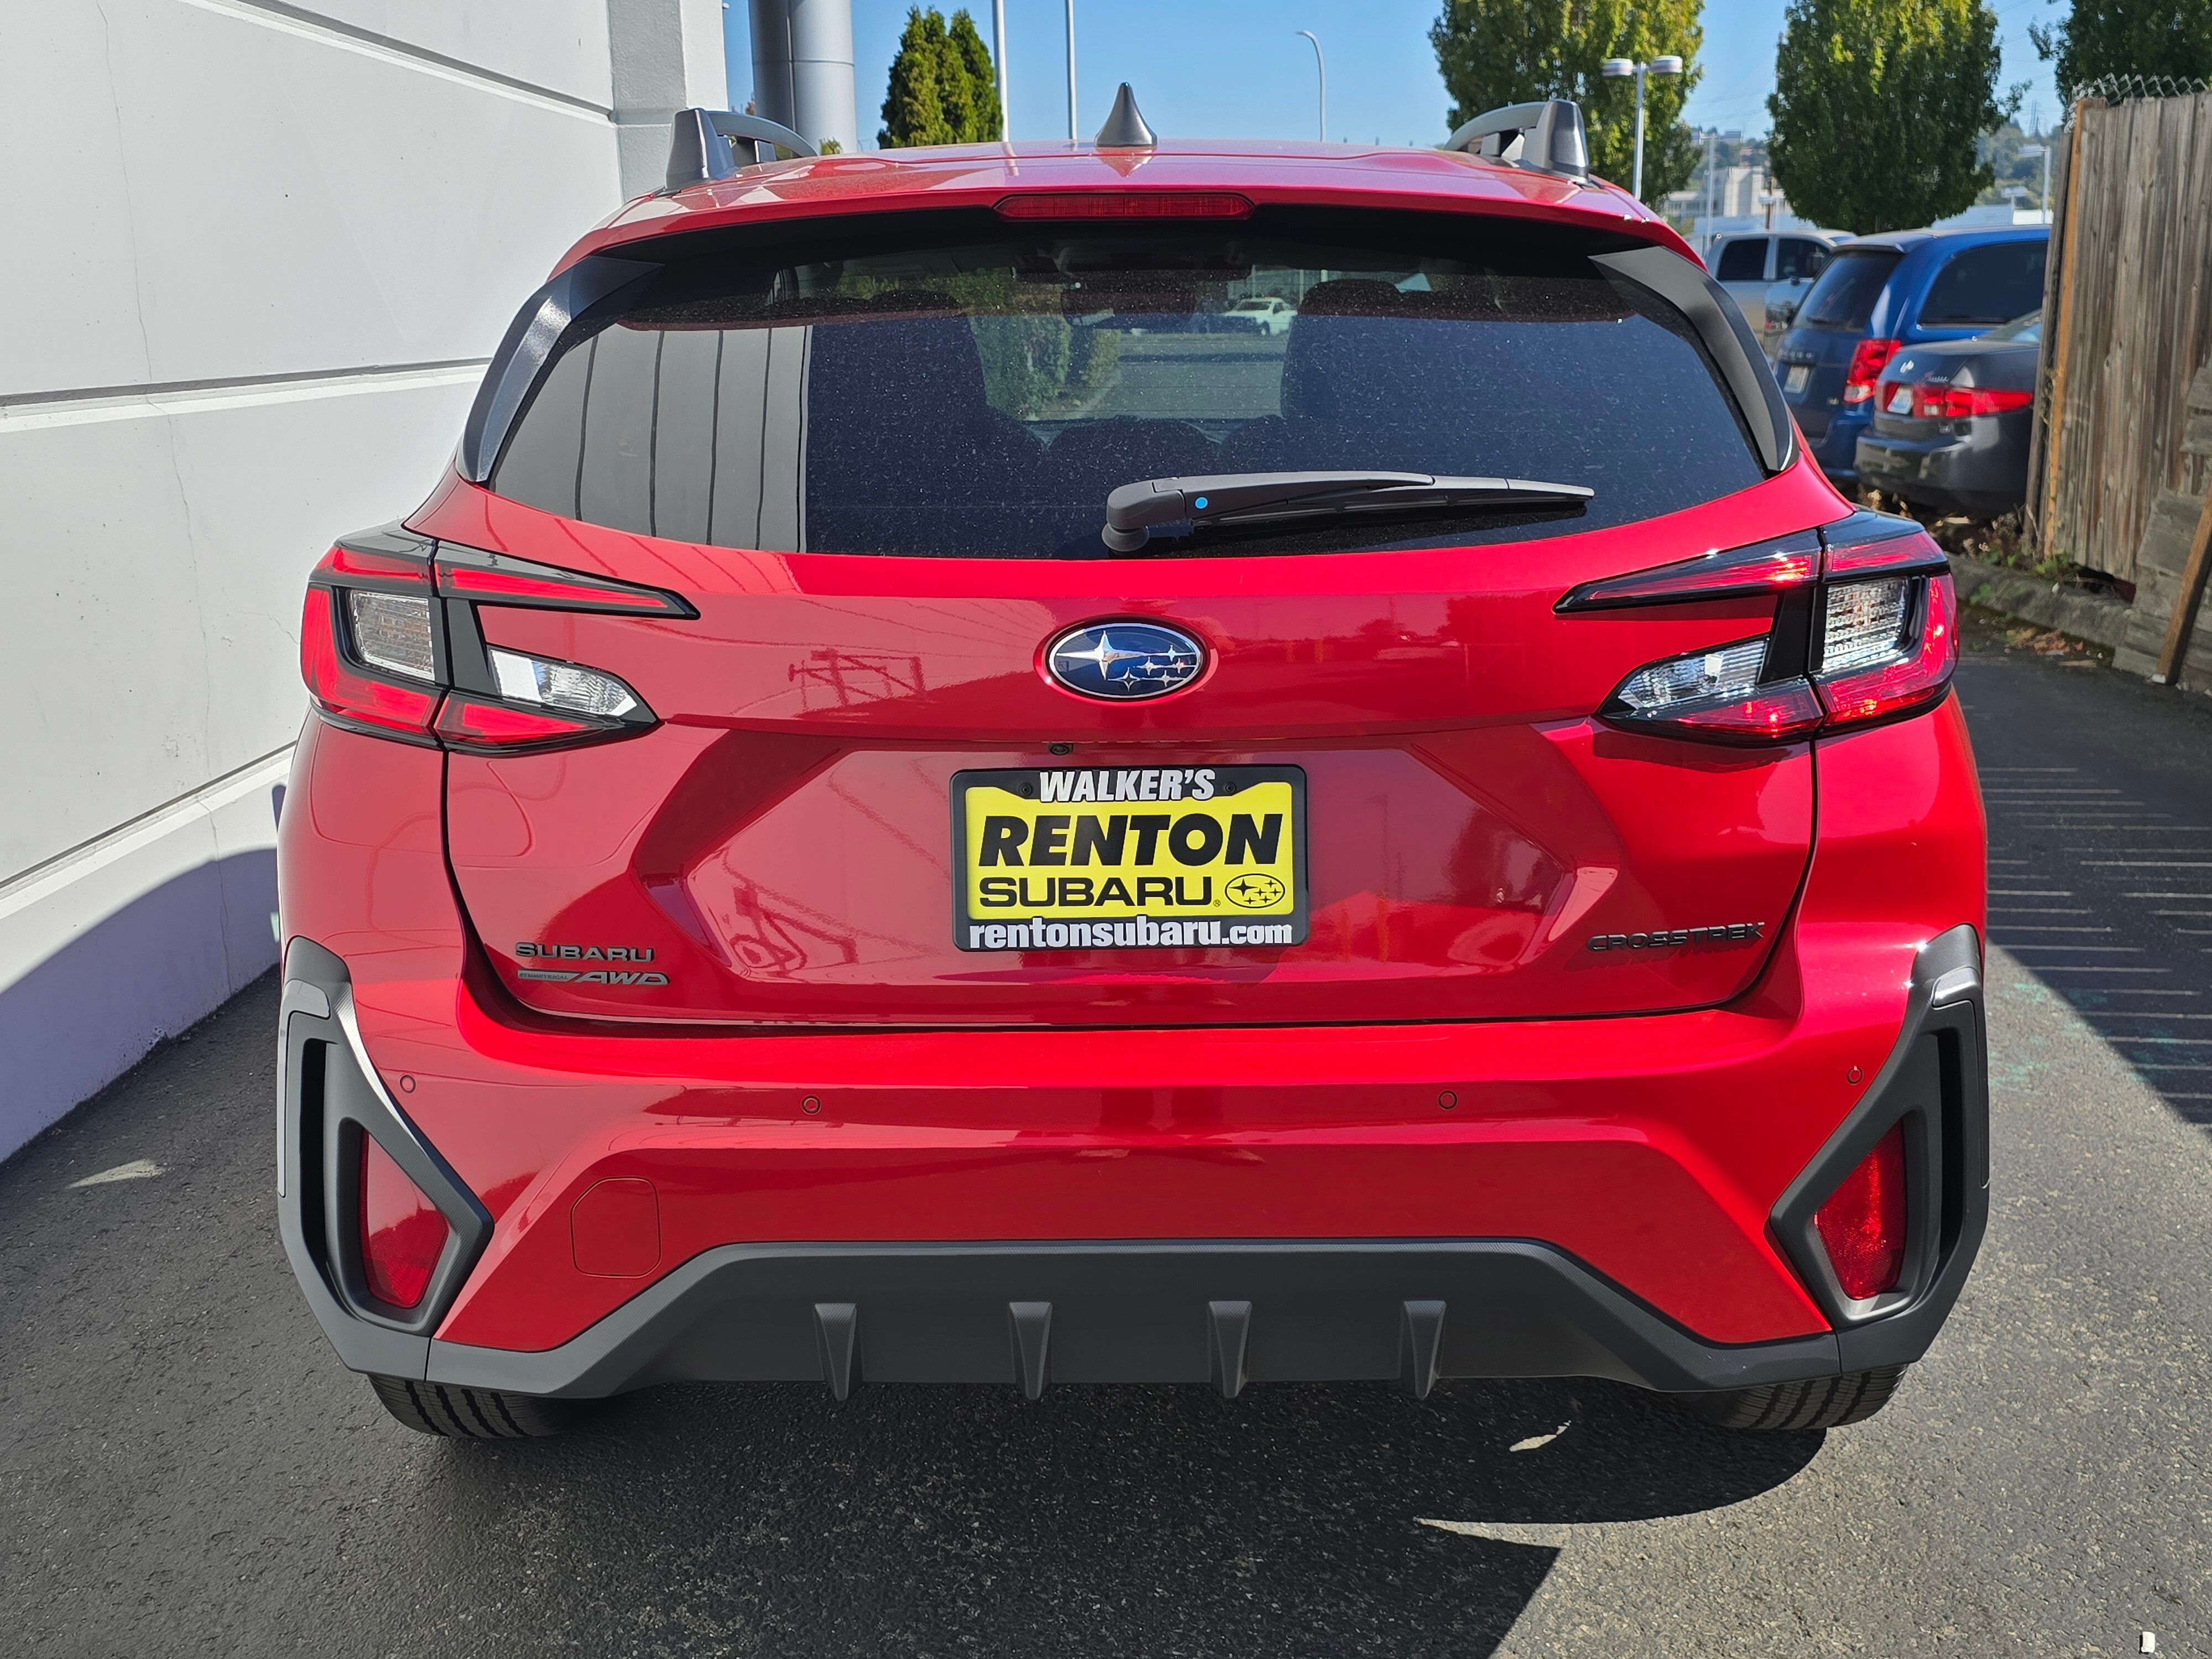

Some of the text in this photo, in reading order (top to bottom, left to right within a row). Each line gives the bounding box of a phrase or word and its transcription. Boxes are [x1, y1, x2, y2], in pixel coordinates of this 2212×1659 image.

[1040, 769, 1215, 802] WALKER'S
[978, 813, 1283, 867] RENTON
[979, 876, 1212, 907] SUBARU
[969, 916, 1292, 948] rentonsubaru.com
[1587, 922, 1765, 951] CROSSTREK
[515, 942, 654, 962] SUBARU
[574, 971, 670, 985] AWD
